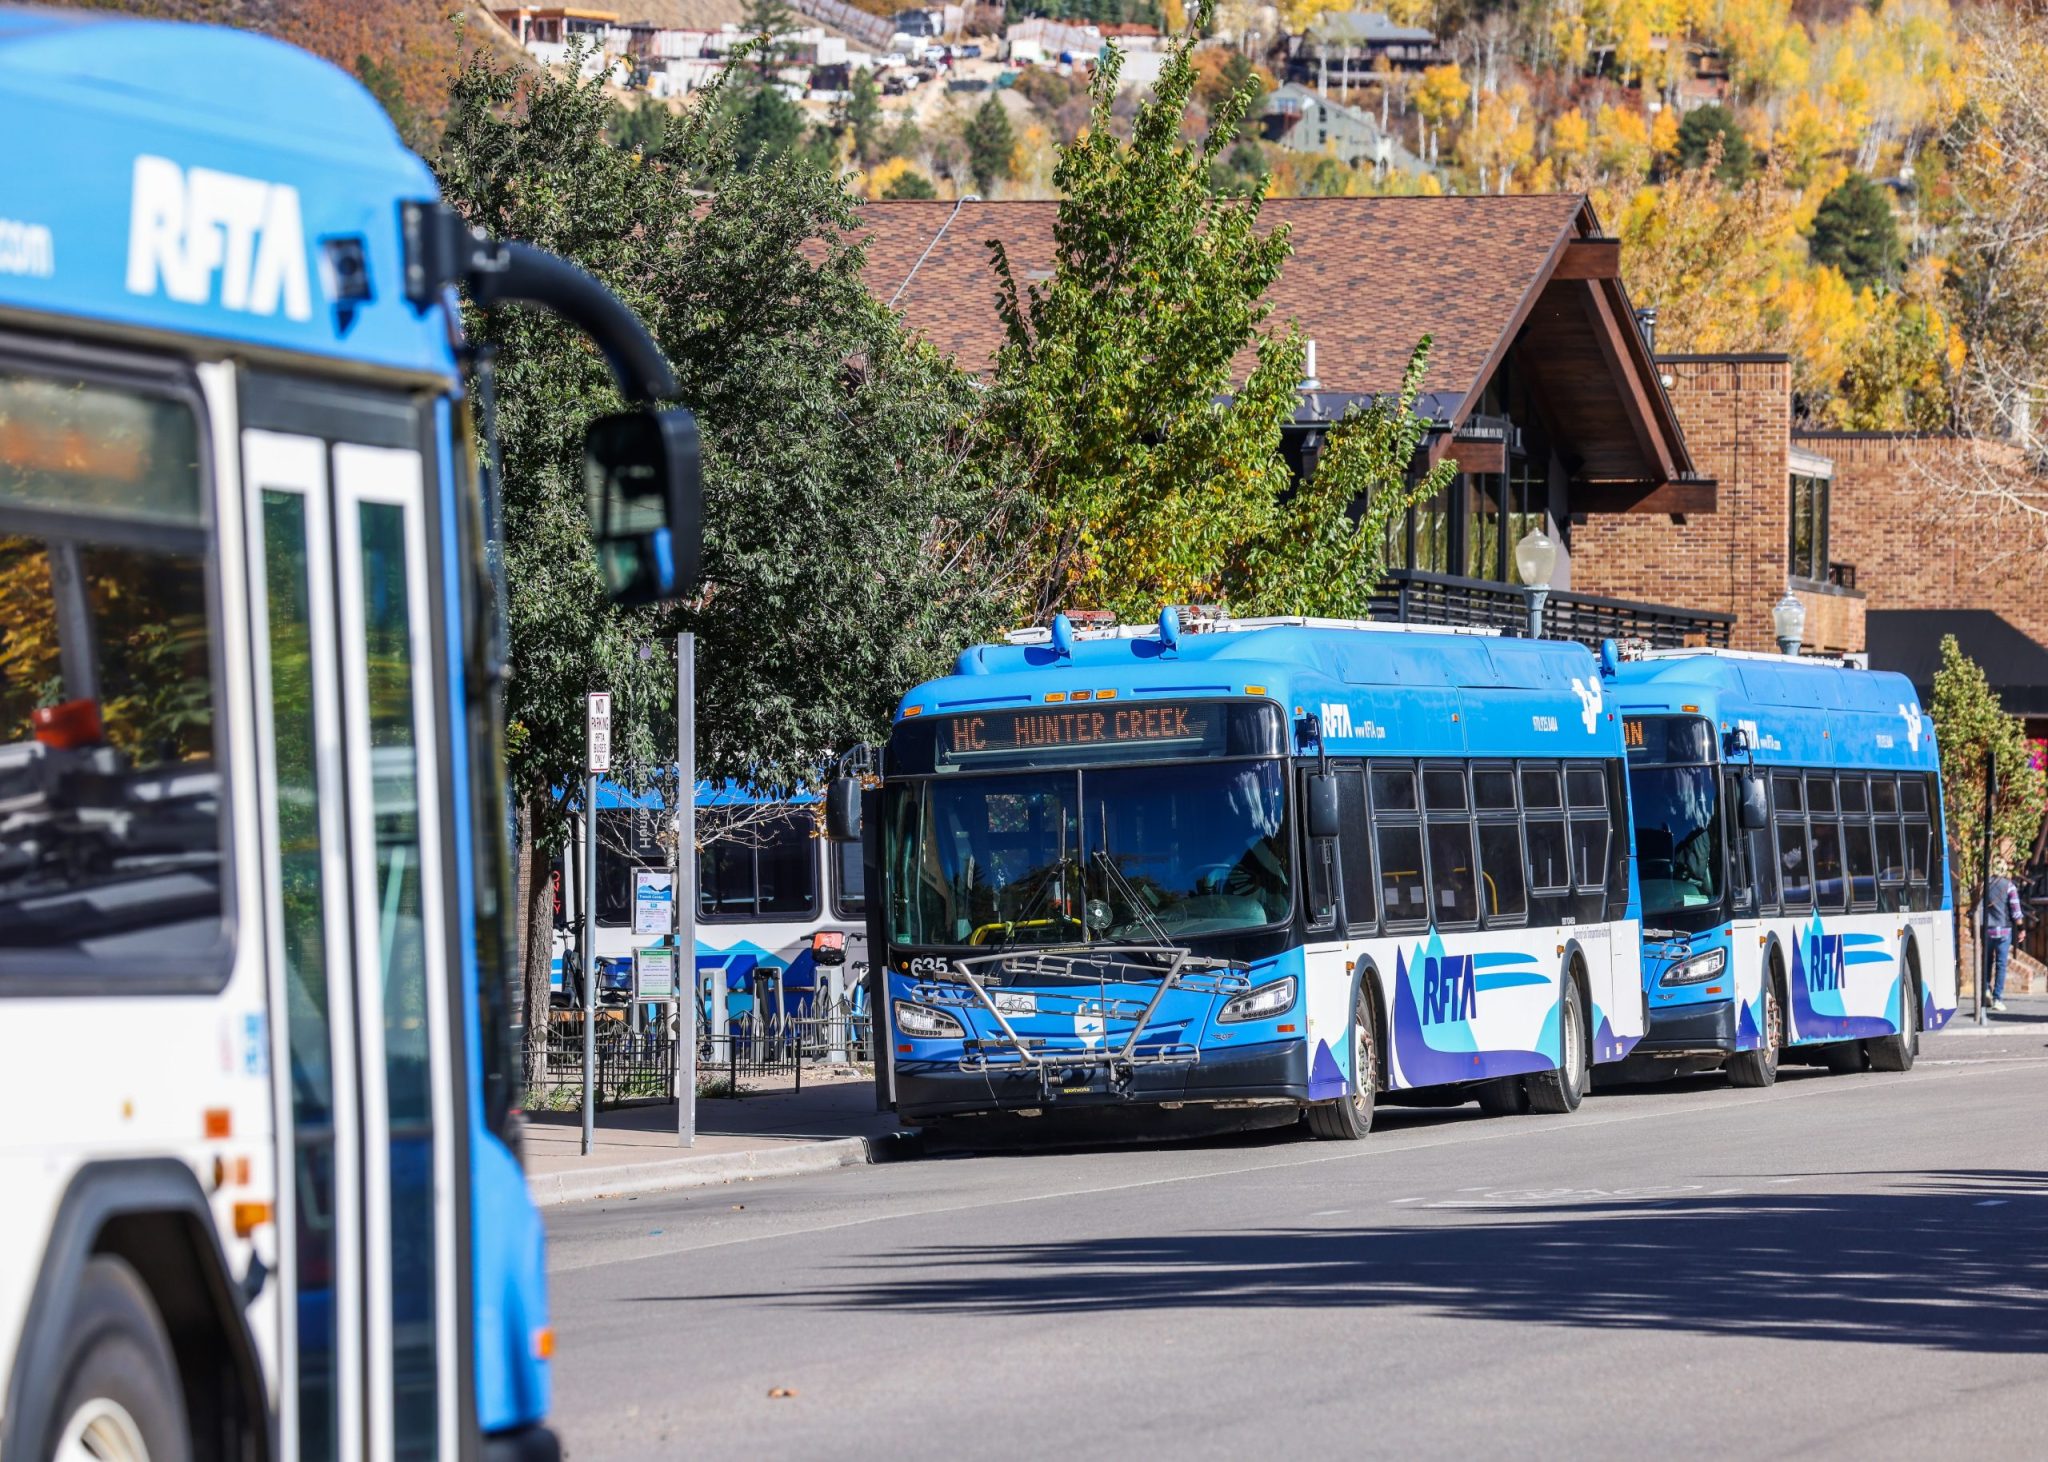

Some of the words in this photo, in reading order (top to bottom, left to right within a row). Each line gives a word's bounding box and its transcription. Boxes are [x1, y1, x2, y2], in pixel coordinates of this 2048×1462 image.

[126, 154, 311, 322] RFTA
[591, 717, 609, 730] PARKING
[595, 698, 605, 714] NO
[1321, 703, 1353, 738] RFTA
[953, 717, 986, 751] HC
[1015, 712, 1105, 745] HUNTER
[1115, 707, 1190, 739] CREEK
[593, 743, 607, 753] BUSES
[594, 754, 605, 763] ONLY
[1810, 934, 1845, 992] RFTA
[1423, 954, 1477, 1026] RFTA
